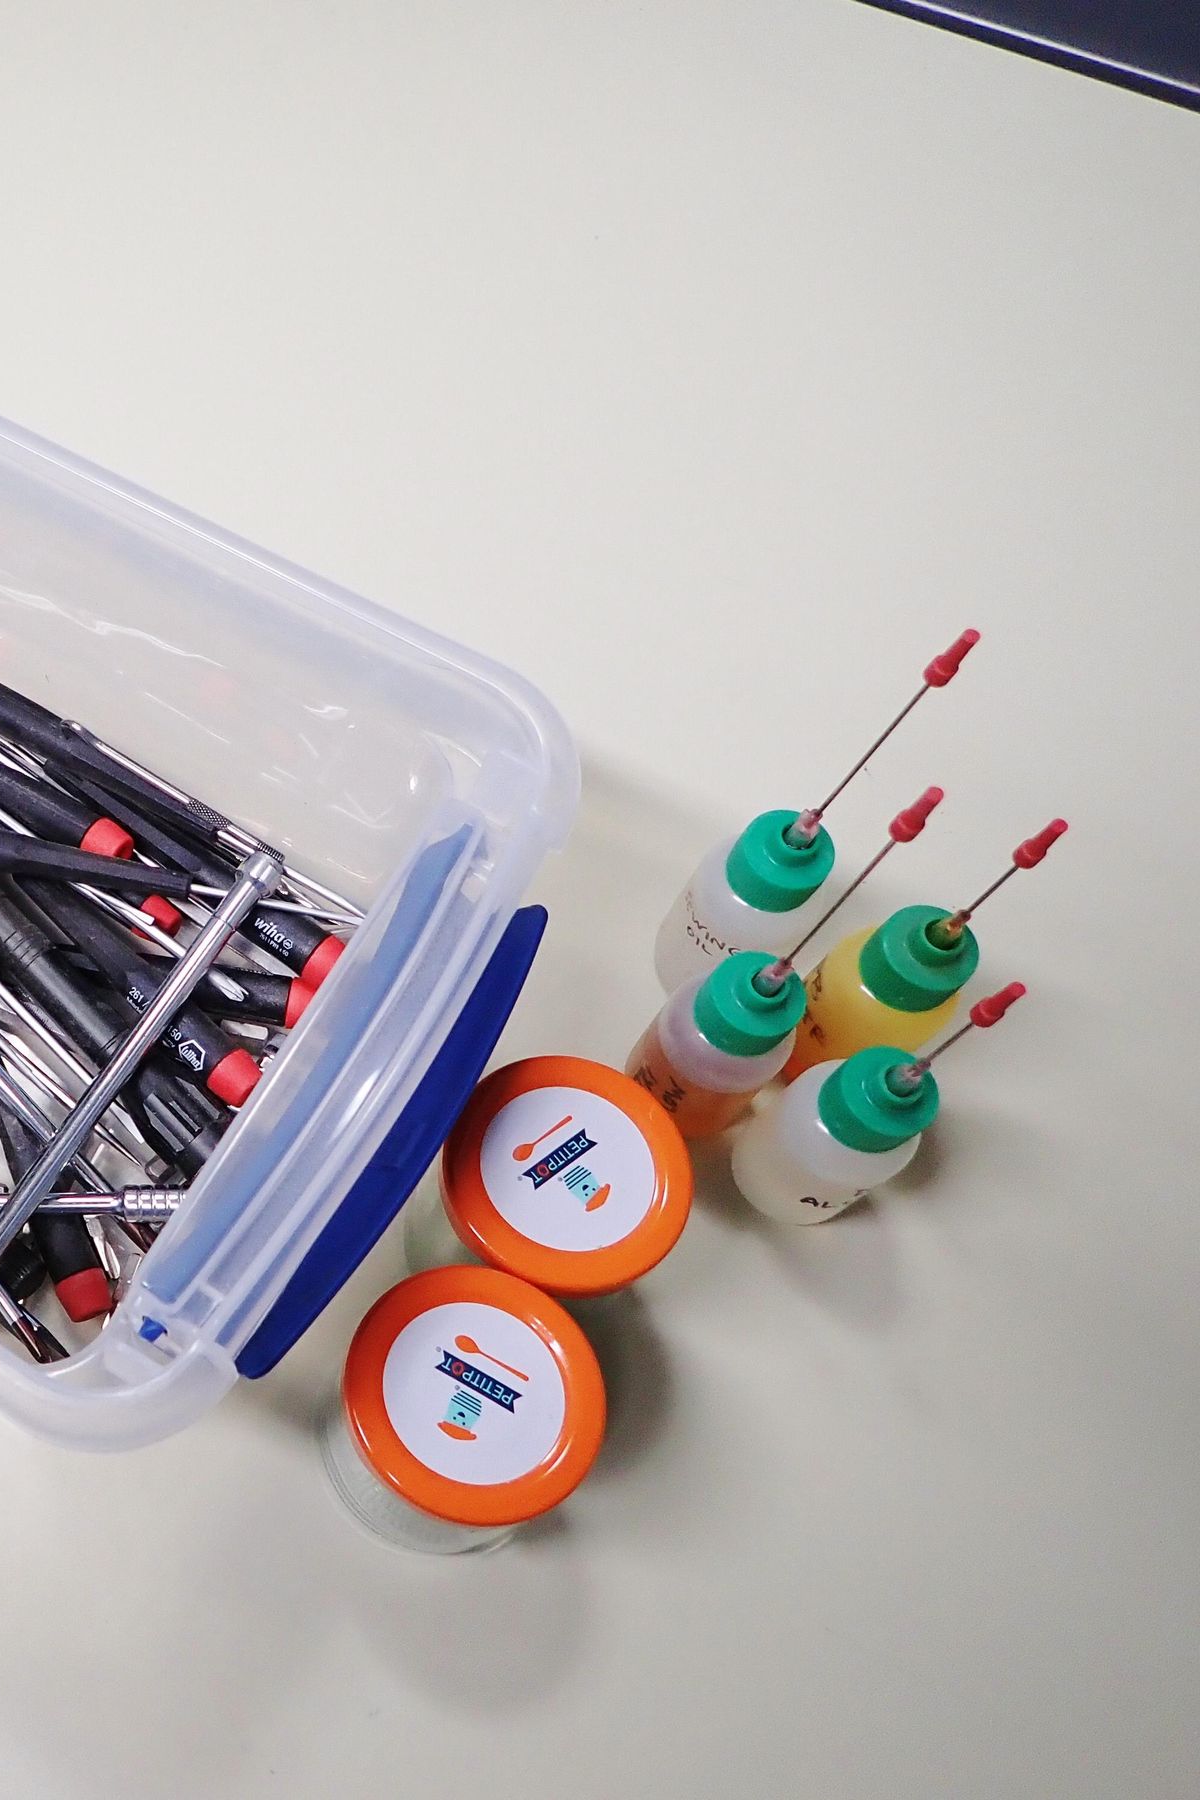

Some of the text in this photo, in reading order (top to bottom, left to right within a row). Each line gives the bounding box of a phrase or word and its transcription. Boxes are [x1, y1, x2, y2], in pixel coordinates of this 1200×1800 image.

[254, 917, 285, 943] wiha
[128, 987, 144, 1002] 261
[531, 1136, 589, 1184] PETITPOT
[441, 1358, 514, 1405] PETITPOT
